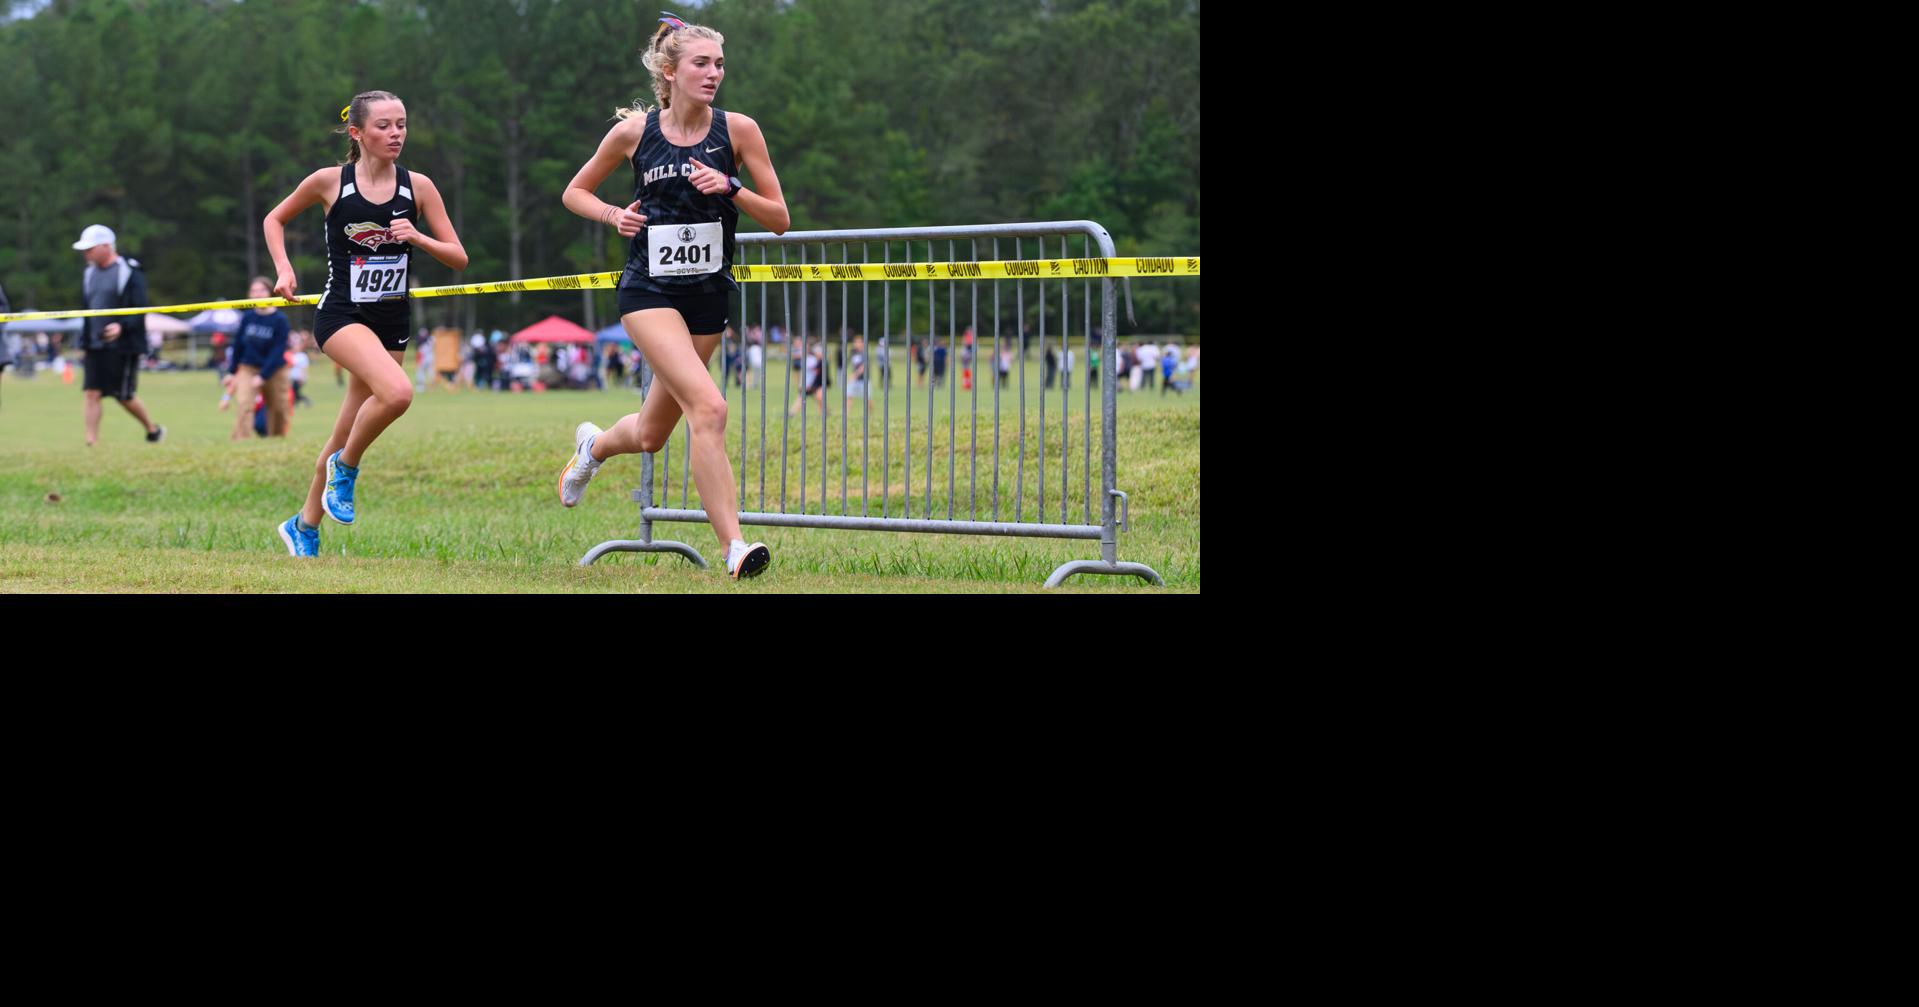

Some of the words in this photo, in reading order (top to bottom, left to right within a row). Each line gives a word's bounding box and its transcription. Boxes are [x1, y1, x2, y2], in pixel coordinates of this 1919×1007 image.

[642, 163, 678, 187] MILL
[659, 243, 711, 265] 2401
[771, 265, 803, 279] CUIDADO
[830, 264, 863, 279] CAUTION
[883, 264, 917, 278] CUIDADO
[947, 263, 982, 277] CAUTION
[1004, 261, 1040, 276] CUIDADO
[1072, 258, 1108, 275] CAUTION
[1136, 258, 1174, 274] CUIDADO
[355, 268, 406, 293] 4927
